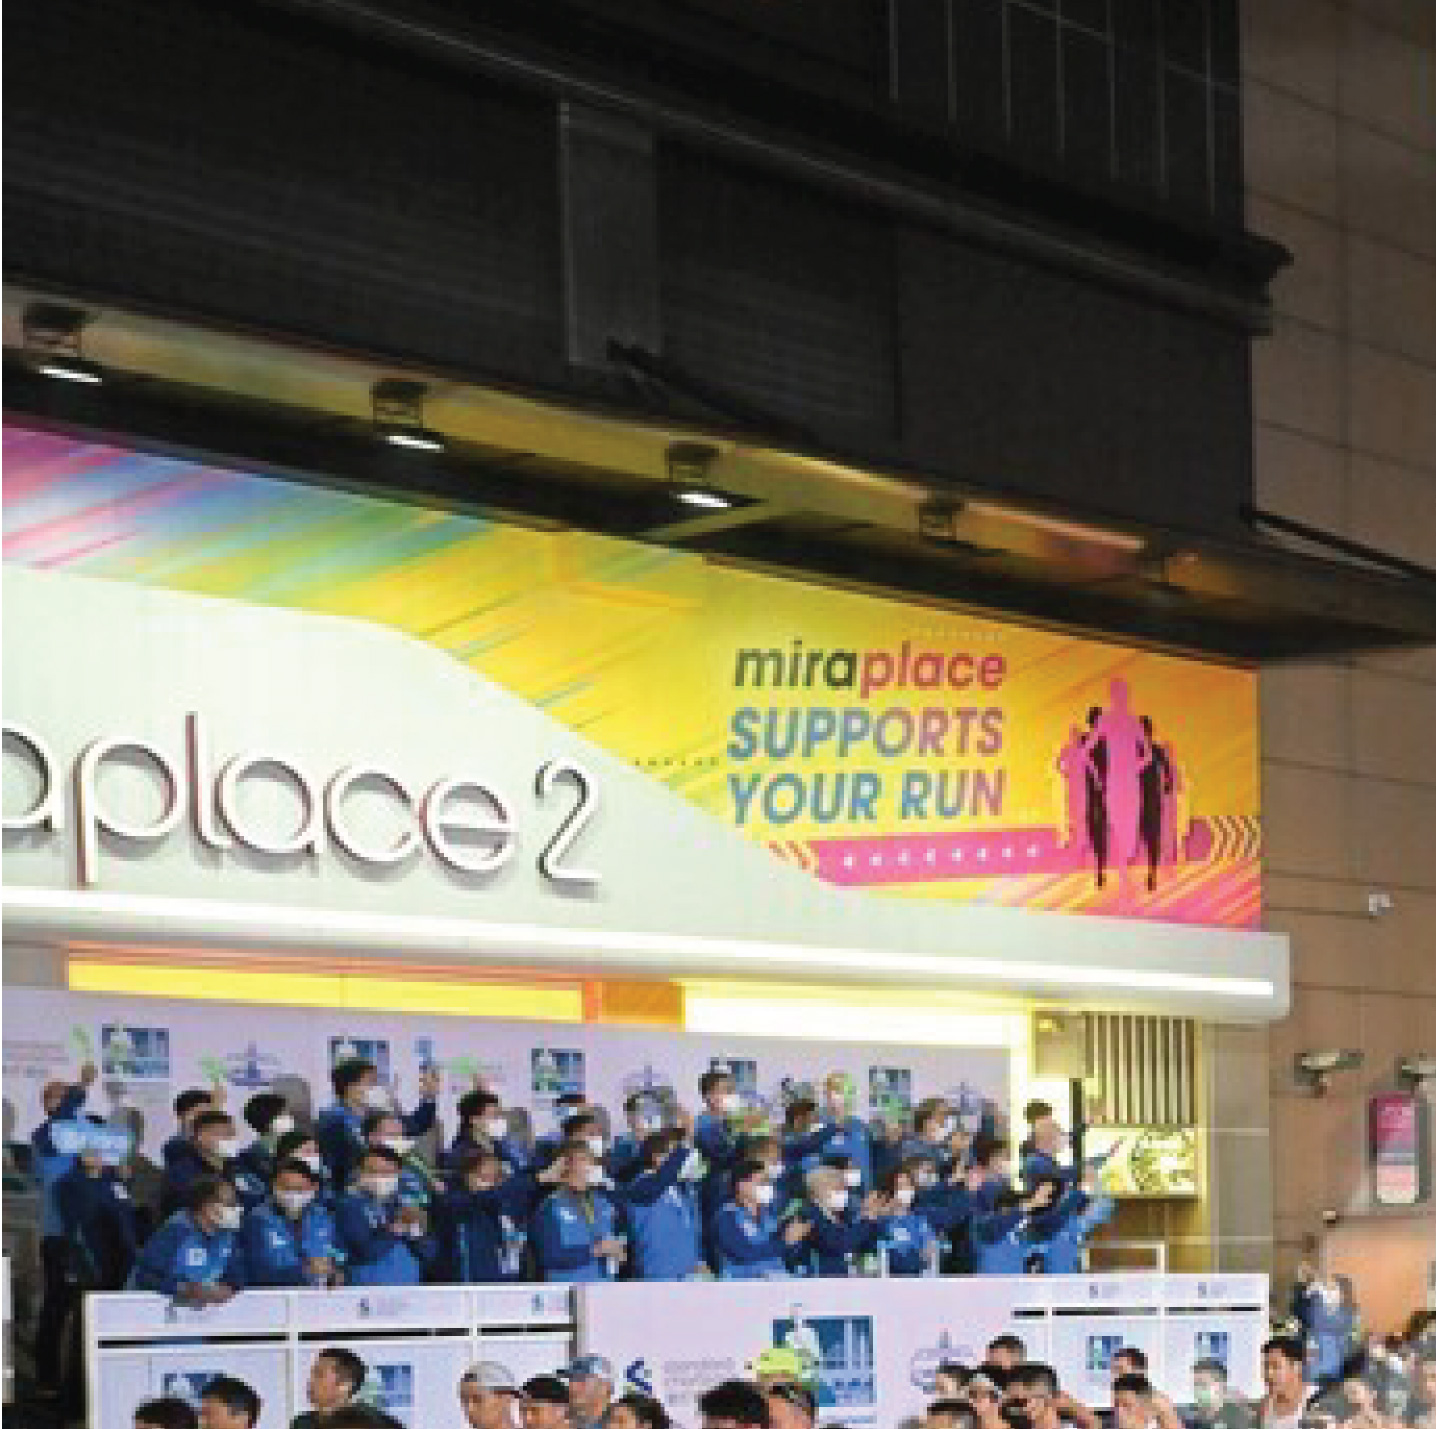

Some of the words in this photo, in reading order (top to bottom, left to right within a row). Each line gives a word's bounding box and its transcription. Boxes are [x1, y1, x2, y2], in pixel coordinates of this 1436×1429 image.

[733, 639, 1006, 698] miraplace
[727, 706, 1003, 762] SUPPORTS
[535, 756, 603, 882] 2
[727, 772, 882, 824] YOUR
[900, 768, 1003, 820] RUN
